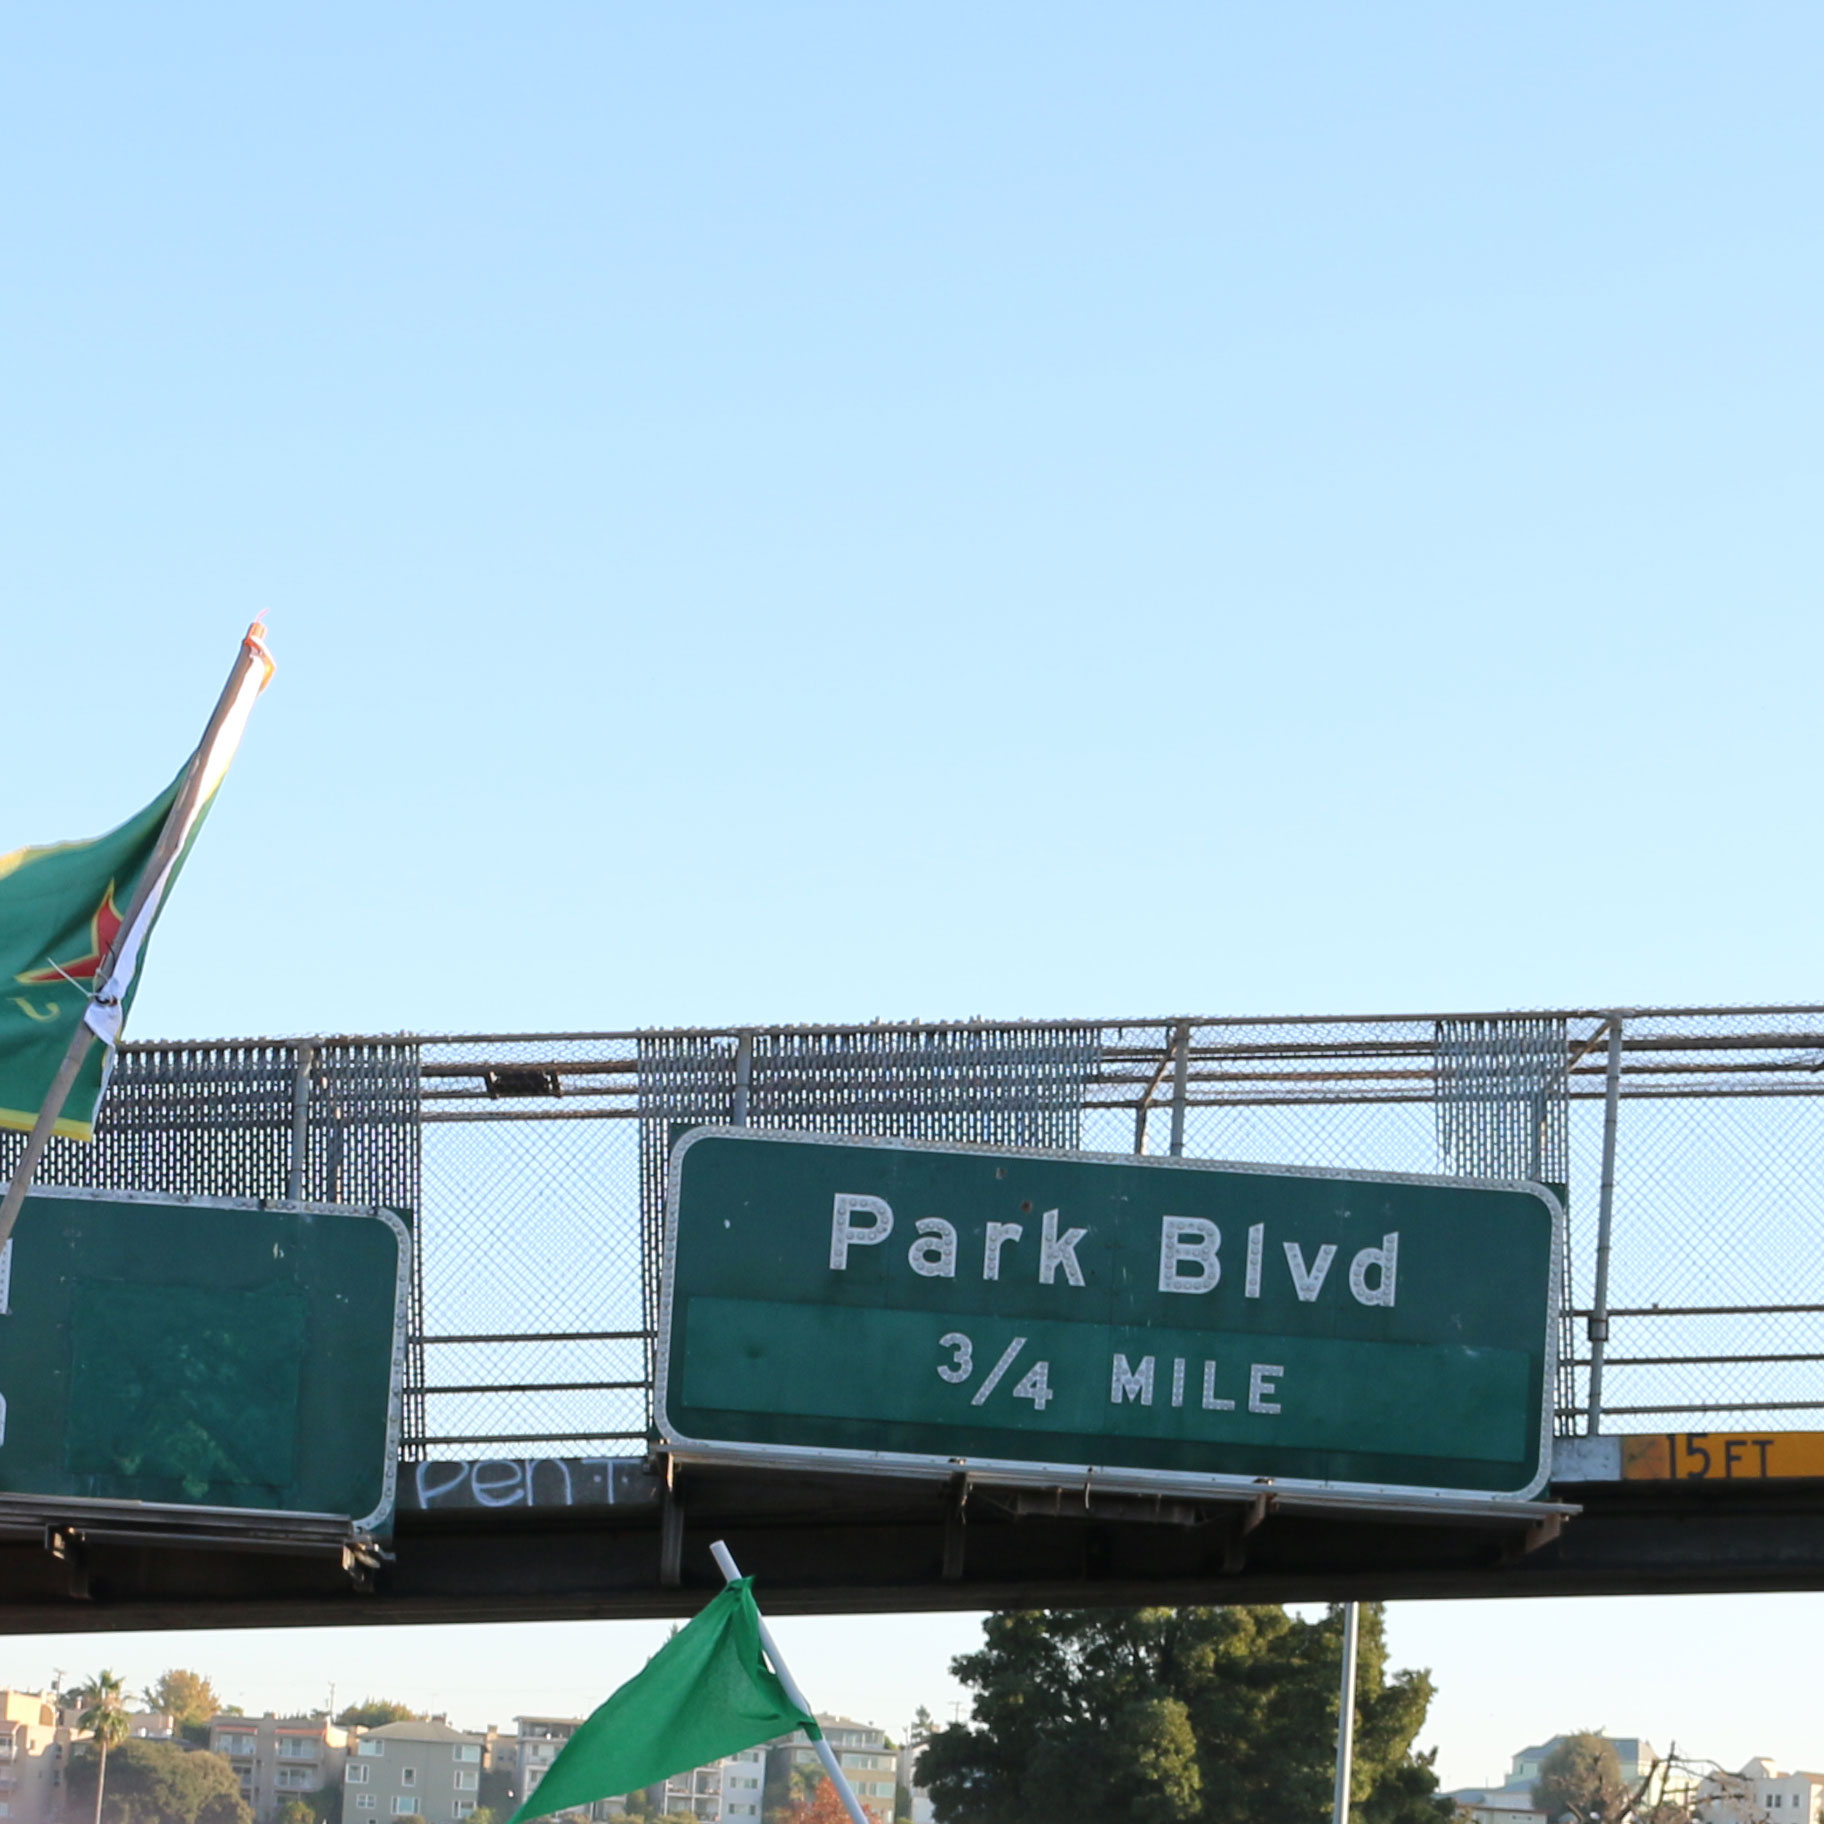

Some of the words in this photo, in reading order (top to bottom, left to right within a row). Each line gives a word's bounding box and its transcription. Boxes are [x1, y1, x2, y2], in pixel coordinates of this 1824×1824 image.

[828, 1192, 1088, 1287] Park
[1158, 1214, 1400, 1308] Blvd
[936, 1332, 1054, 1411] 3/4
[1110, 1353, 1285, 1415] MILE
